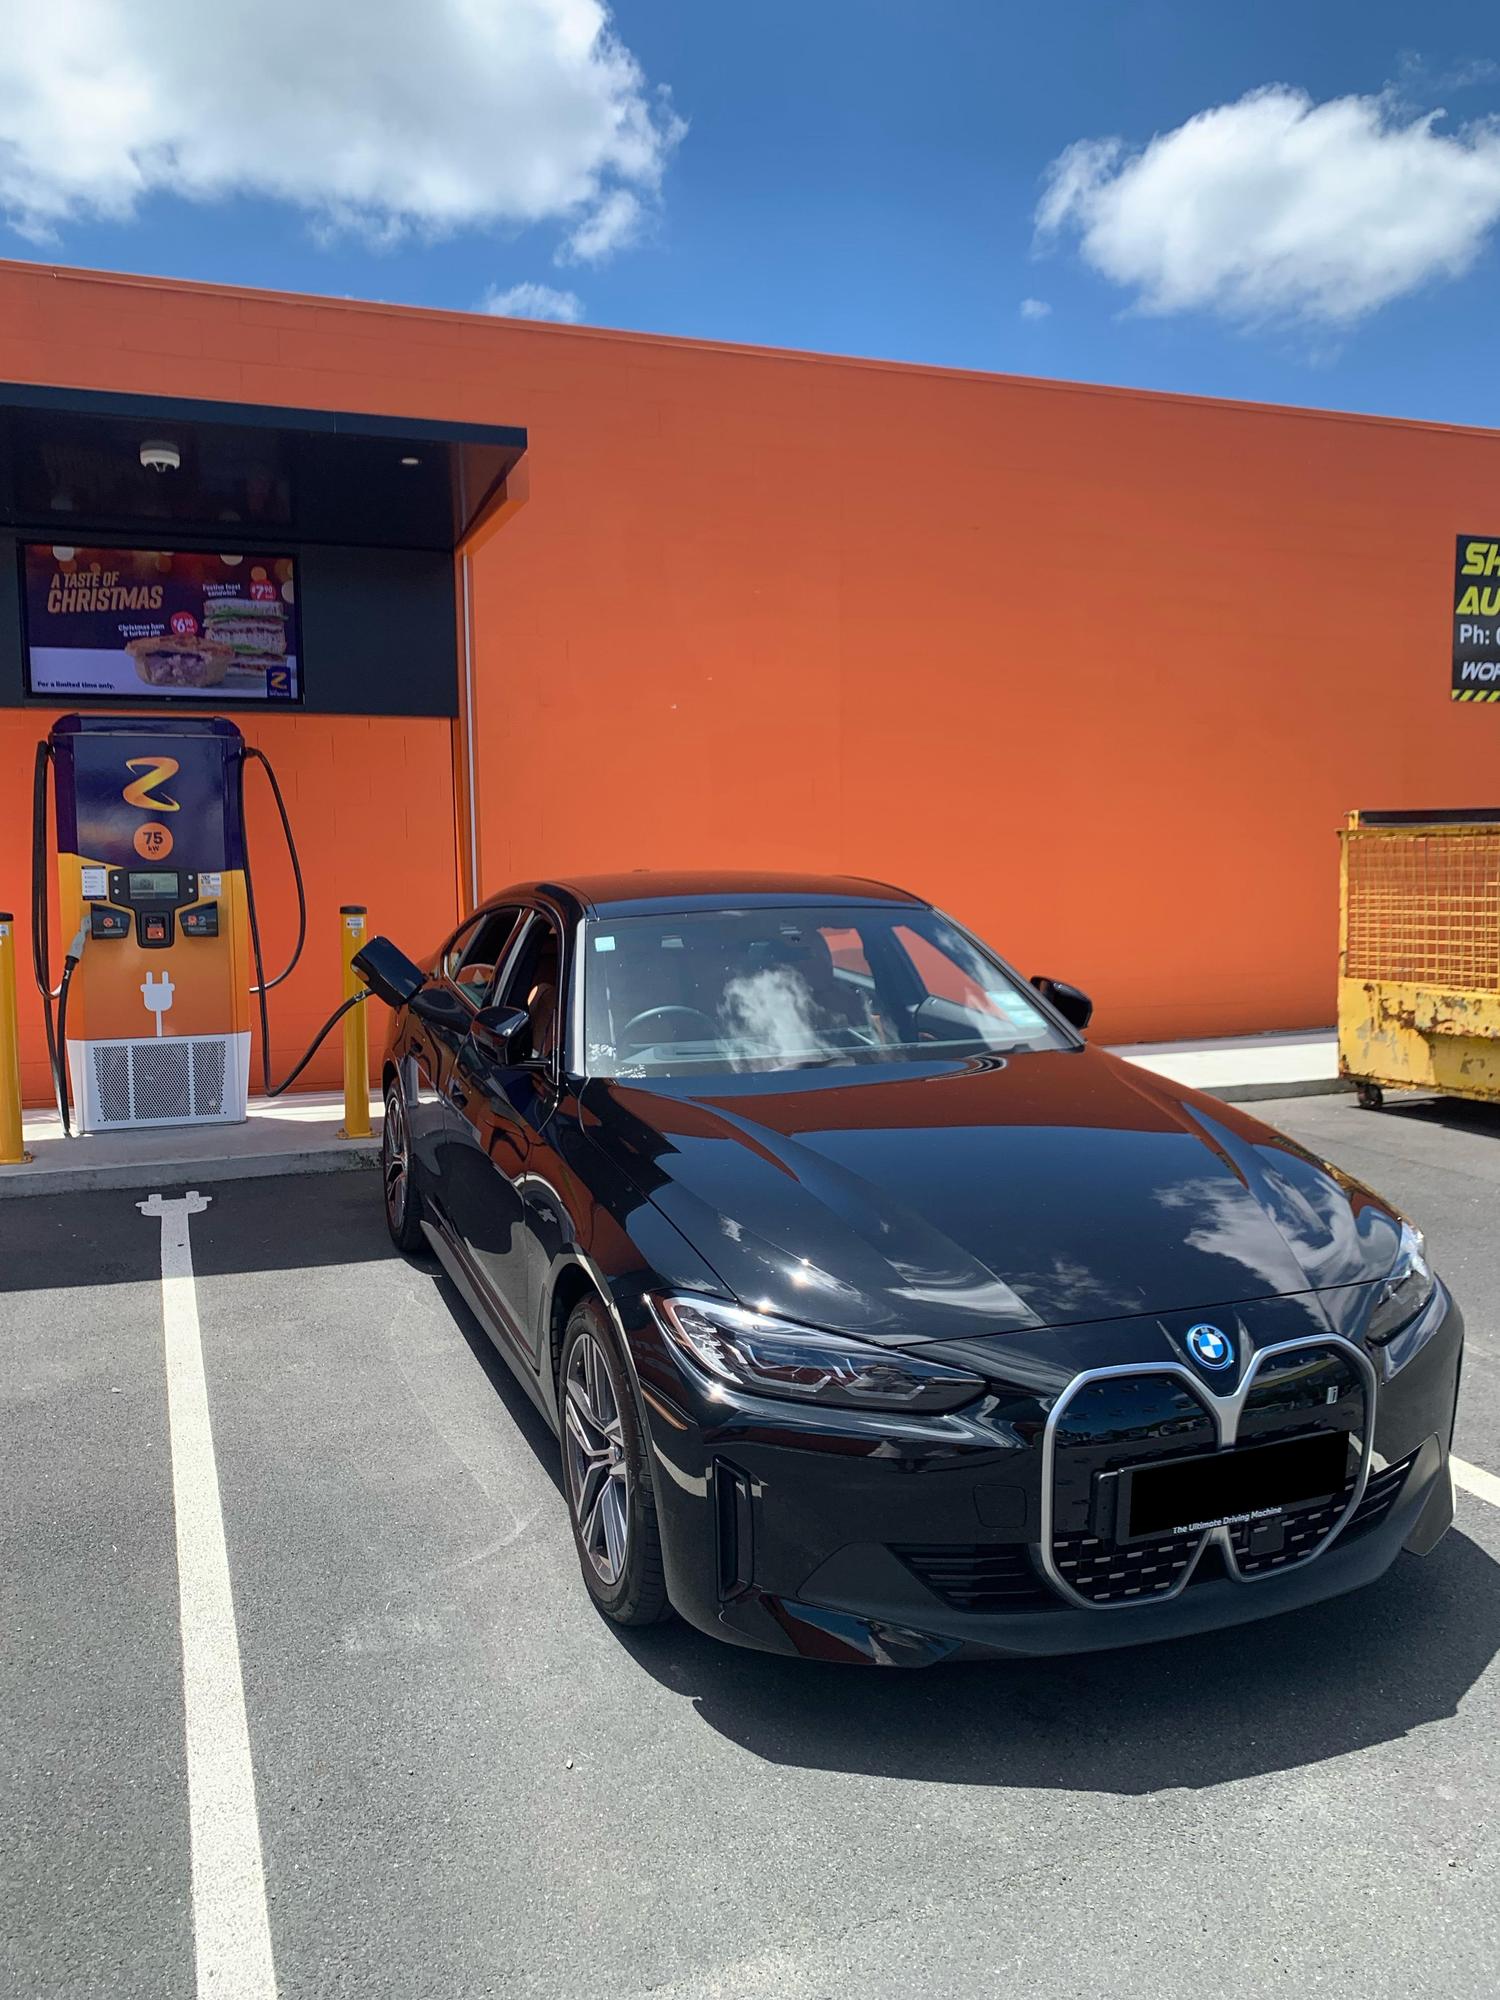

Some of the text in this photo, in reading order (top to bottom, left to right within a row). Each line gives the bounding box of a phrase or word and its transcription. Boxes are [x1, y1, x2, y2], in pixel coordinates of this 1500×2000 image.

[51, 571, 120, 588] A TASTE OF
[47, 585, 163, 613] CHRISTMAS
[129, 629, 149, 637] turkey
[151, 622, 165, 630] ham
[1460, 623, 1490, 645] Ph:
[56, 680, 80, 688] limited
[98, 682, 115, 690] only.
[271, 671, 288, 689] Z
[143, 831, 163, 845] 75
[1173, 1507, 1282, 1534] The Ultimate Driving Machine
